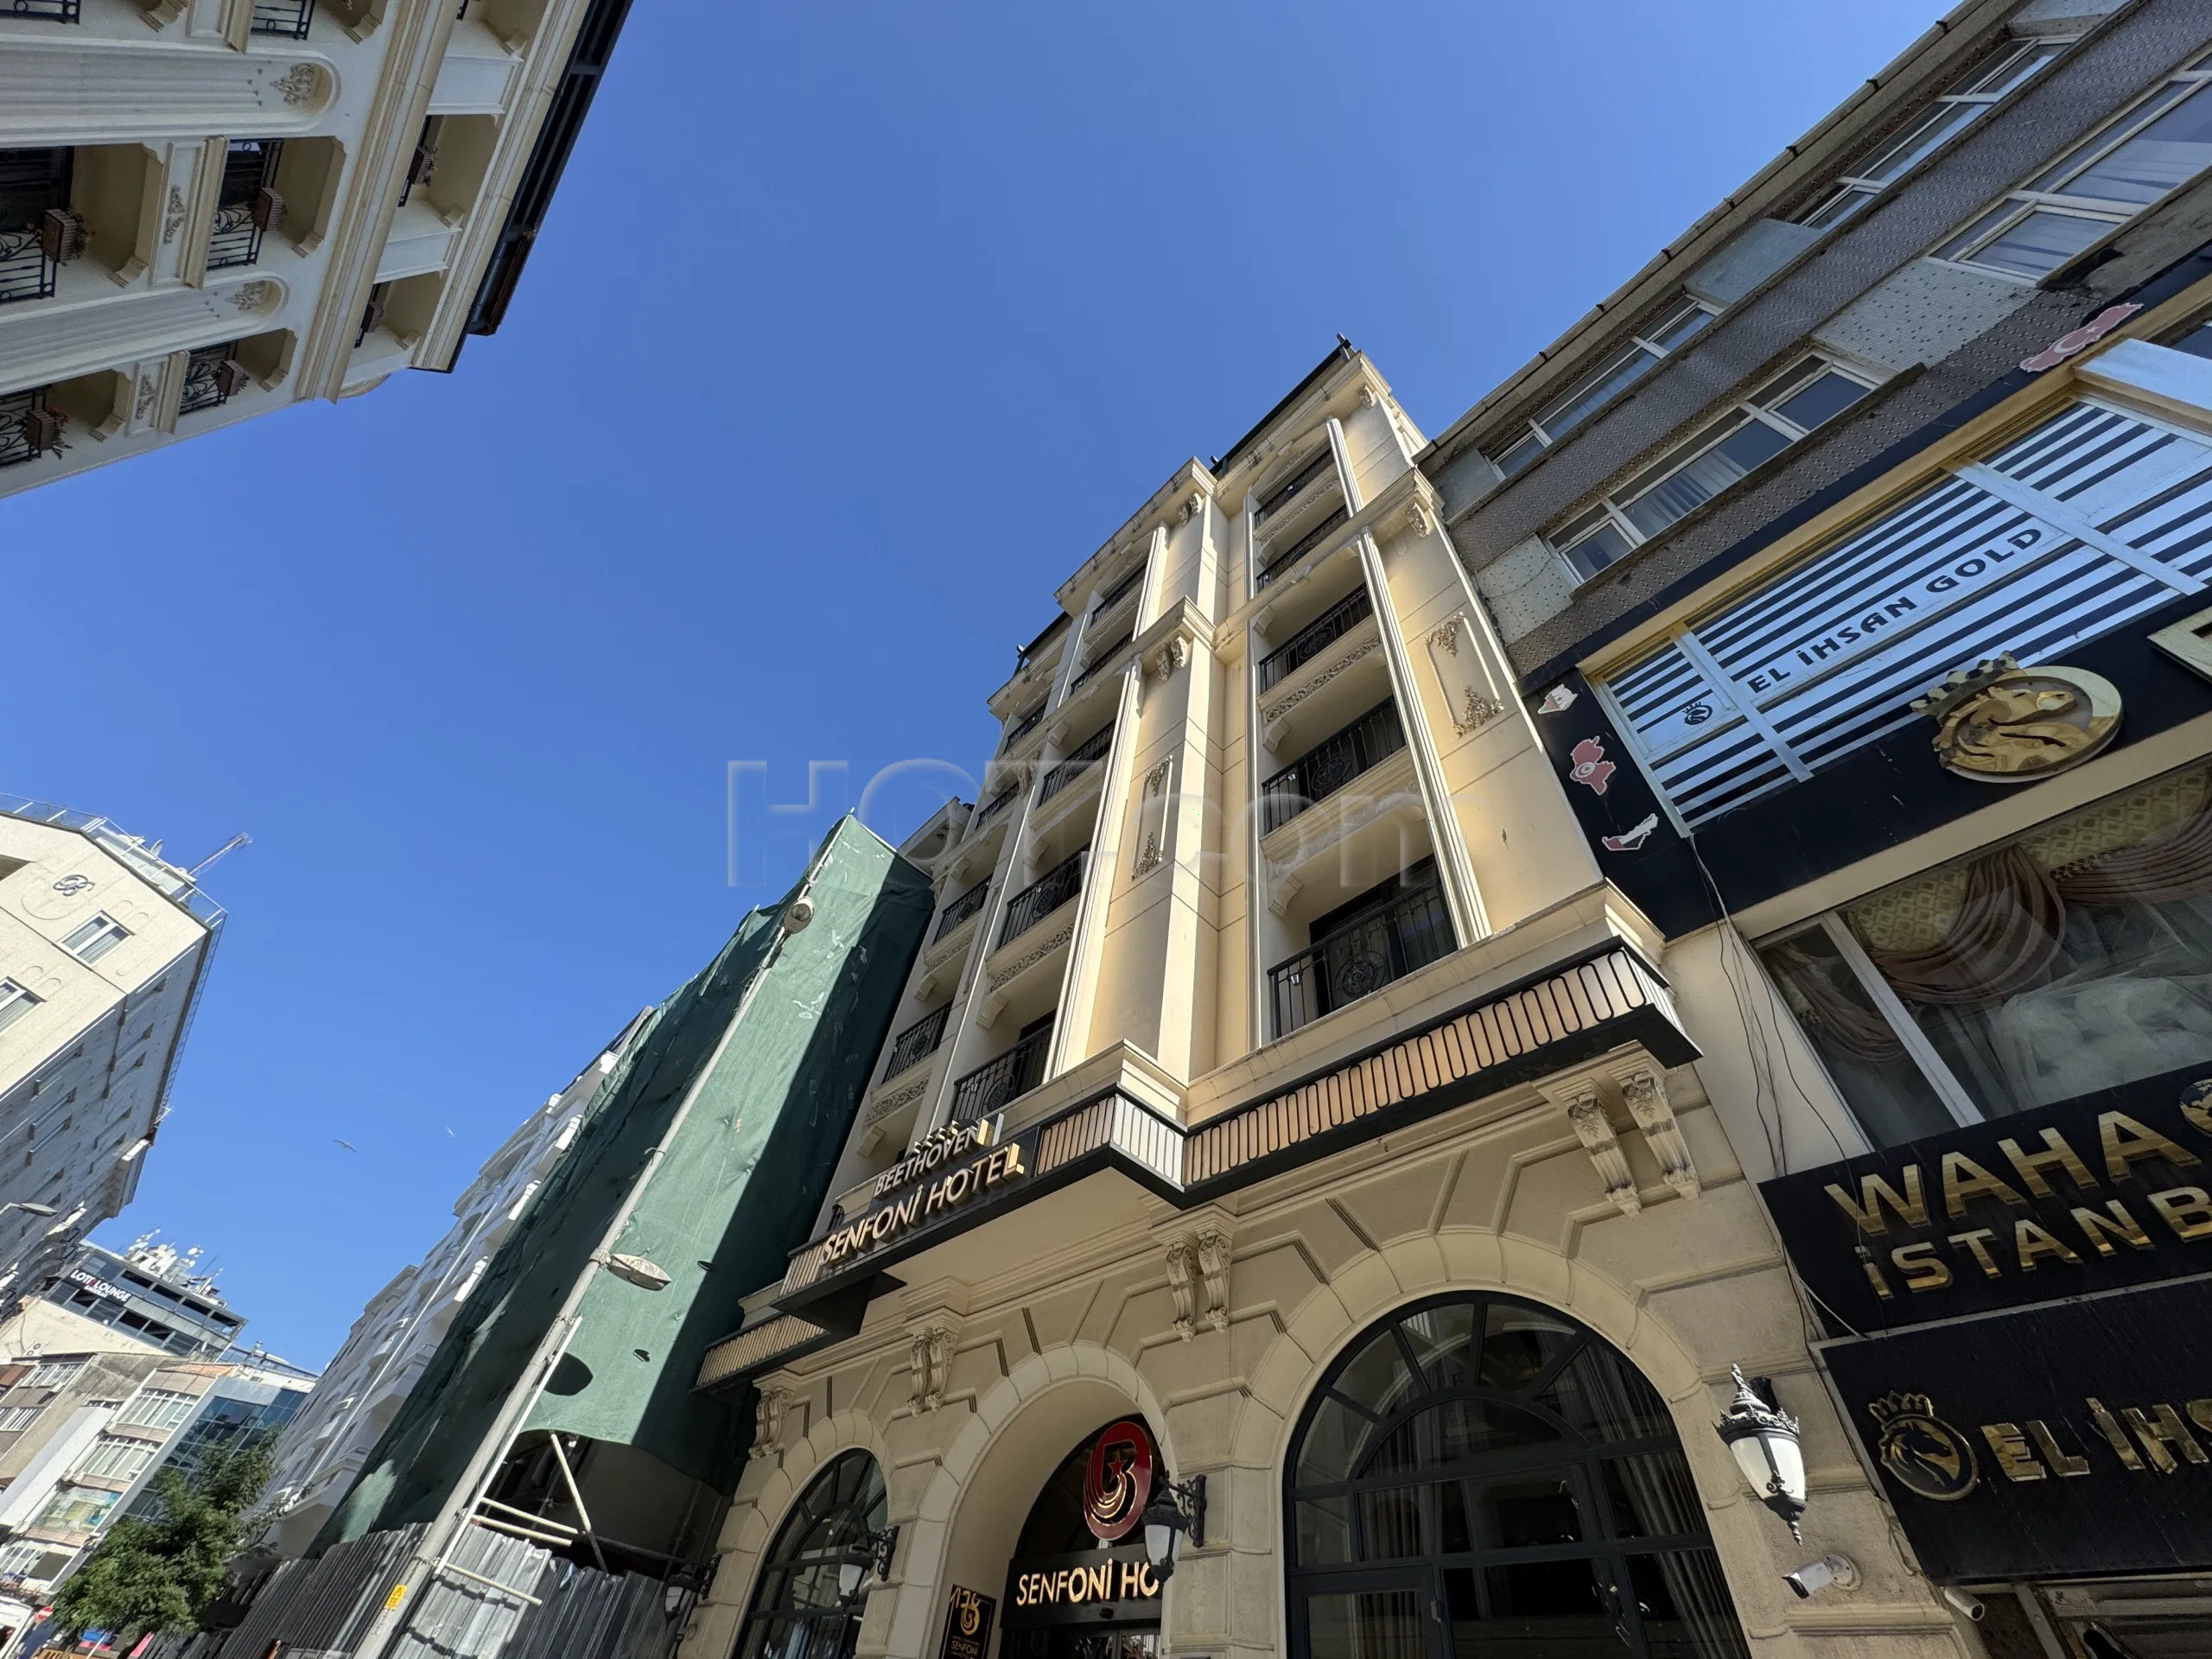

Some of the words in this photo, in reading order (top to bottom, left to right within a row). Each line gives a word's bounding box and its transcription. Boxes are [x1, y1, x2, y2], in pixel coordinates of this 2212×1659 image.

[1746, 667, 1791, 694] EL
[1925, 528, 2043, 594] GOLD
[873, 1125, 987, 1198] BEETHOVEN
[925, 1142, 1025, 1216] HOTEL
[93, 1280, 132, 1302] LOUNGE
[1980, 1419, 2092, 1483] EL
